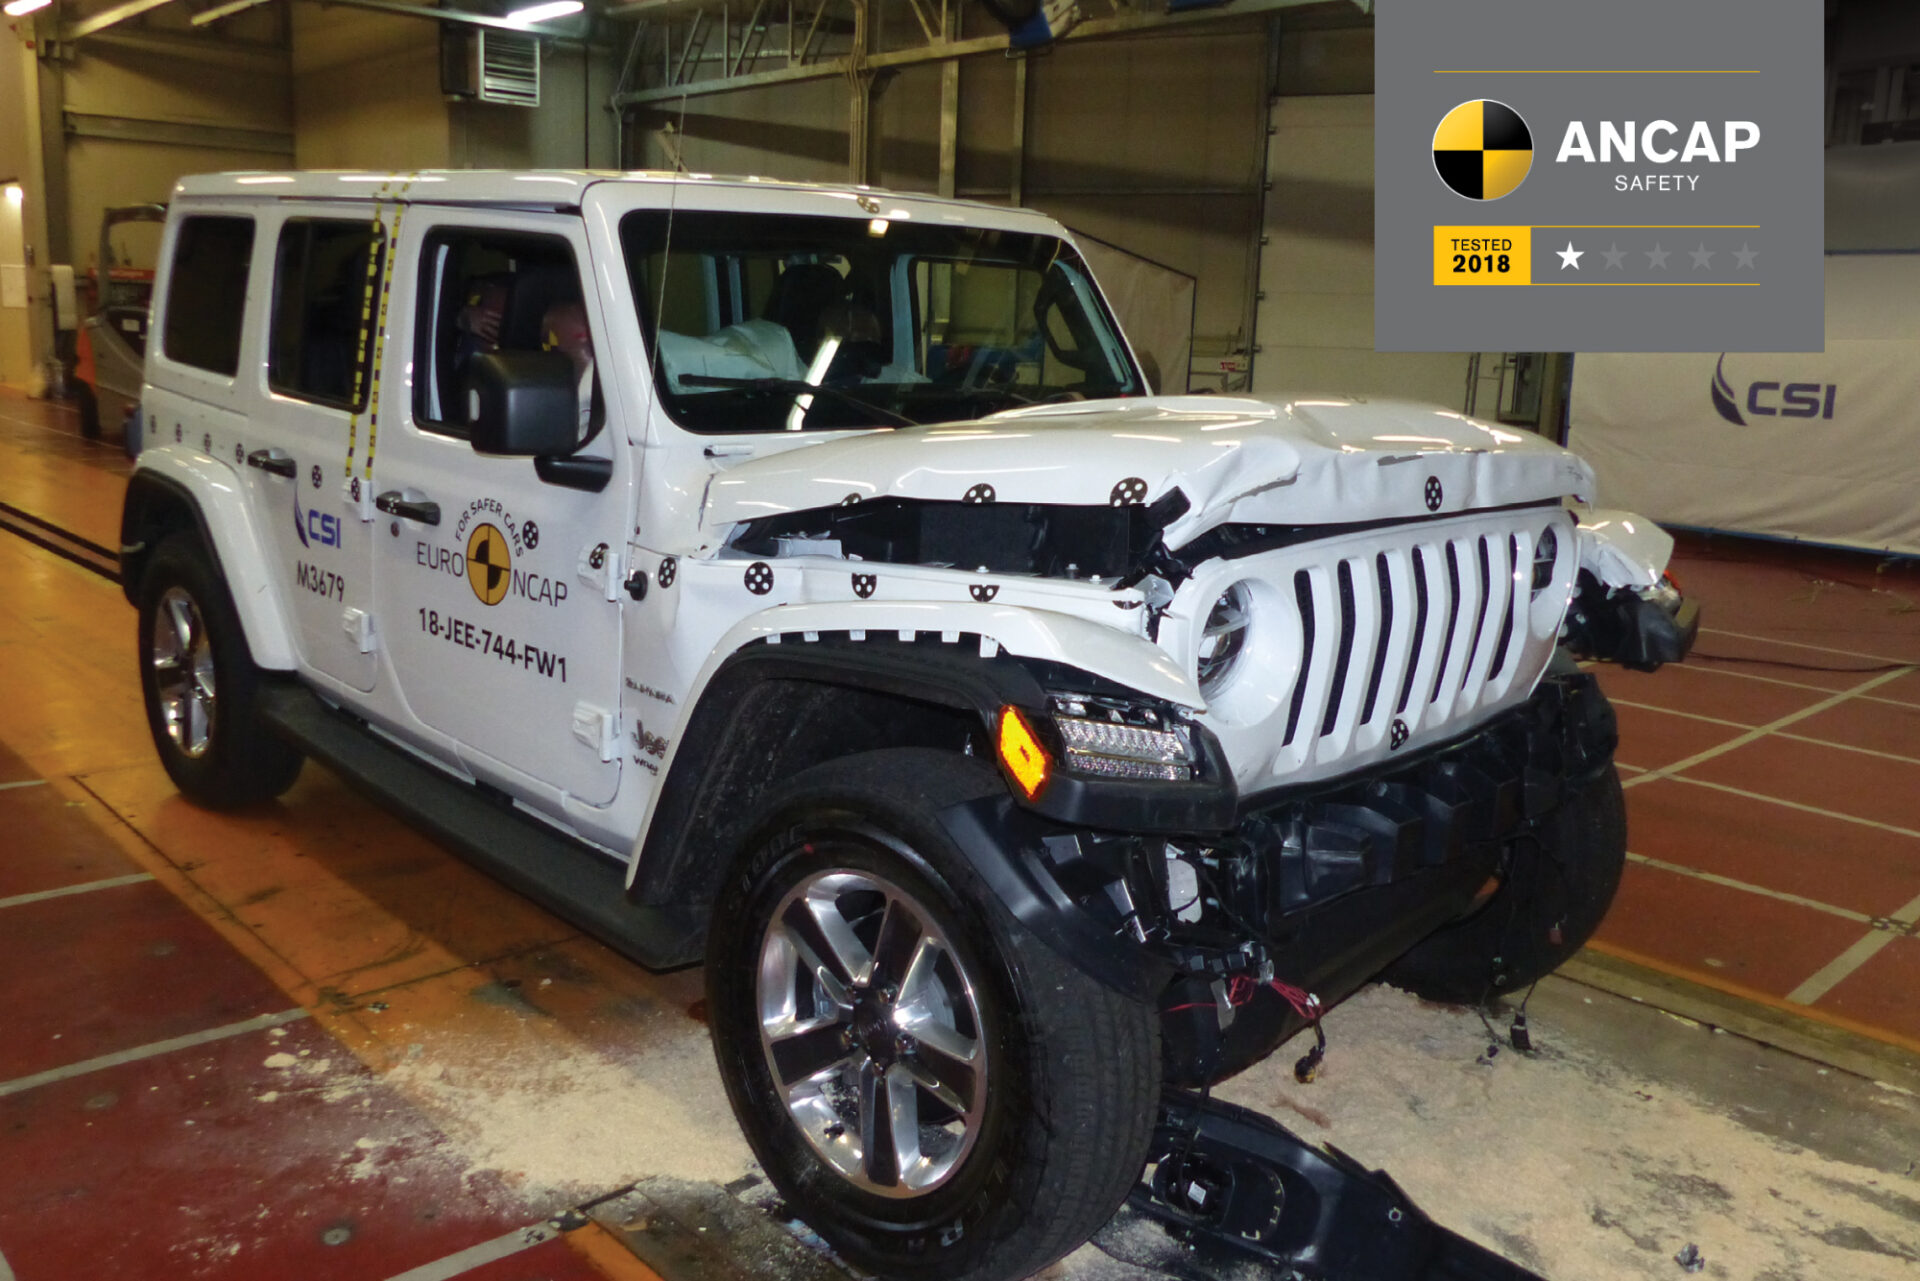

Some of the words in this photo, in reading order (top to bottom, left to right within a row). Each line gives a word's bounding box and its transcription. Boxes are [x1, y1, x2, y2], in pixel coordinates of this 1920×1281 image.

[1747, 381, 1837, 420] CSI
[308, 508, 341, 549] CSI
[455, 511, 472, 542] FOR
[470, 498, 503, 518] SAFER
[503, 512, 525, 559] CARS
[297, 560, 345, 603] M3679
[416, 541, 465, 578] EURO
[513, 569, 568, 608] NCAP
[419, 607, 567, 684] 18-JEE-744-FW1
